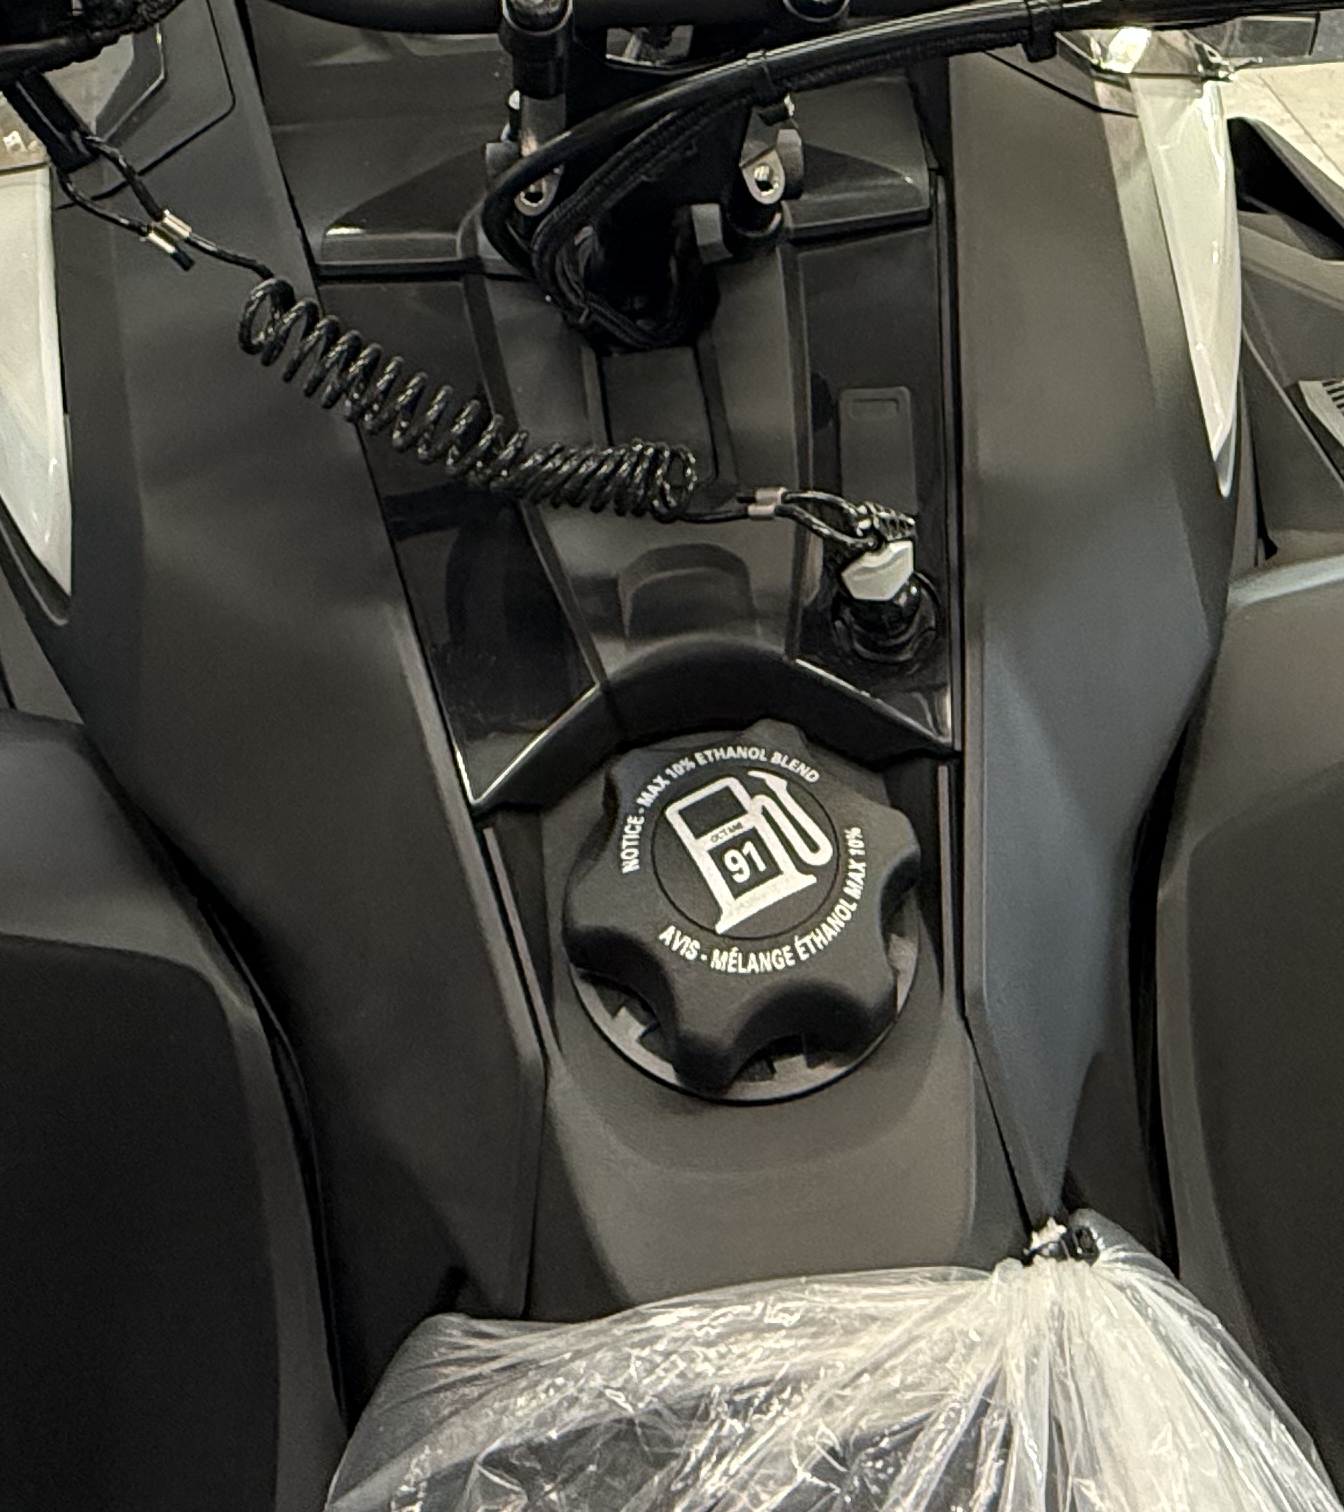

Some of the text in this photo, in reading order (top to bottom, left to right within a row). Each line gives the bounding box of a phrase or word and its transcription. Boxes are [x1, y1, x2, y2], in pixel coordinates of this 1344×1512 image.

[621, 746, 820, 874] NOTICE MAX 10% ETHANOL BLEND
[722, 840, 768, 884] 91
[658, 826, 867, 974] AVIS MÉLANGE ÉTHANOL MAX 10%
